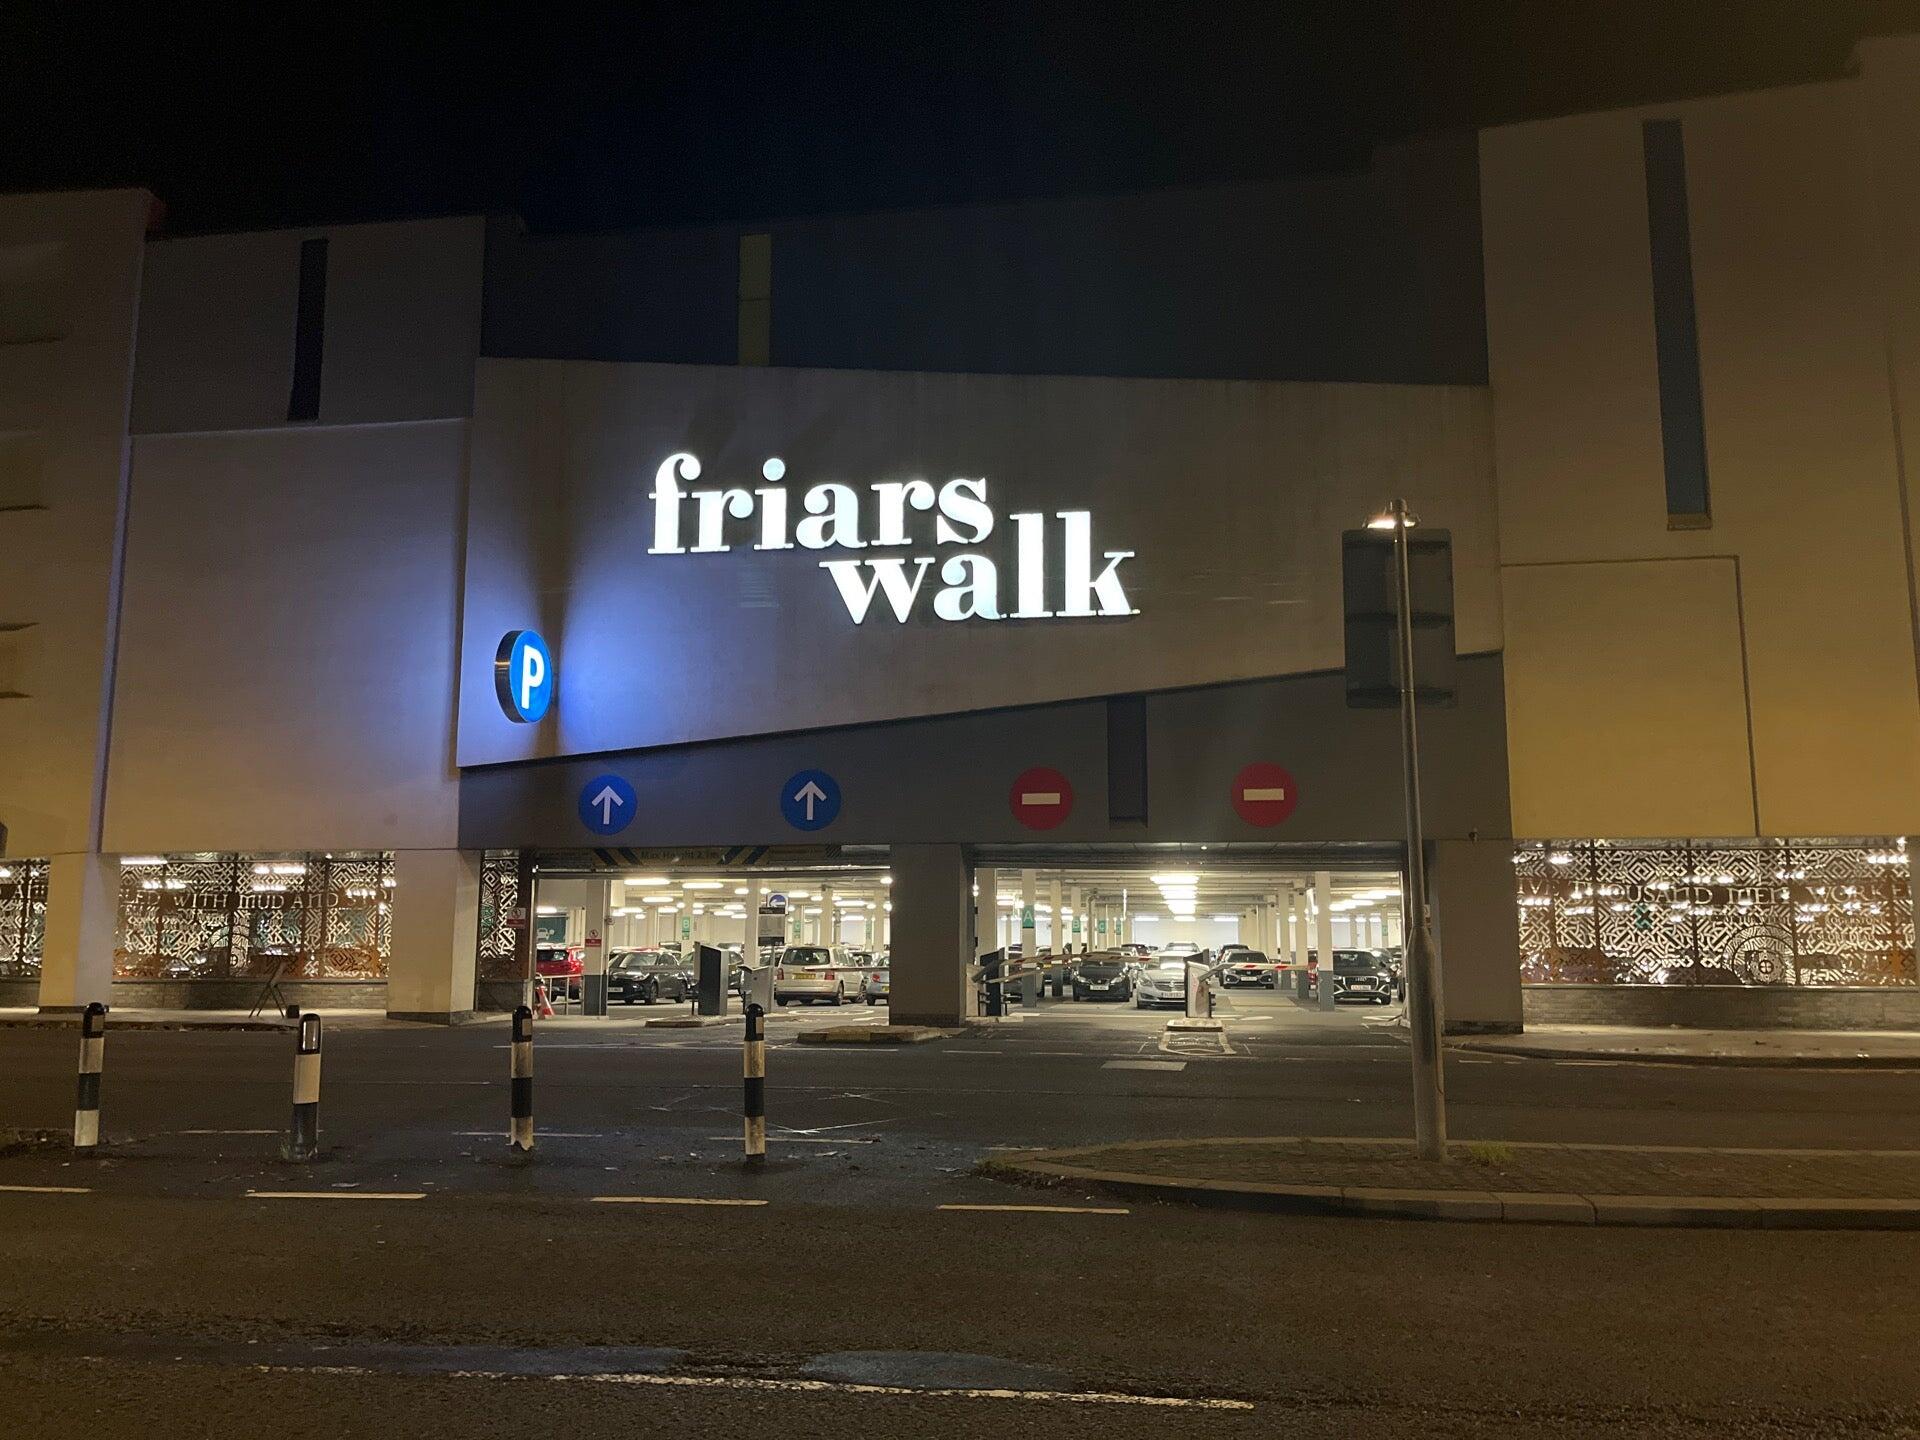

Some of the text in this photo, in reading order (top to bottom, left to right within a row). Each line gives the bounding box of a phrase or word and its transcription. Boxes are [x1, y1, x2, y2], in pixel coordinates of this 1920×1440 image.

[648, 453, 994, 554] friars
[819, 511, 1140, 625] walk
[522, 644, 545, 710] P
[174, 893, 228, 908] WITH
[238, 894, 285, 909] MUD
[291, 893, 339, 908] AND
[1023, 910, 1034, 922] A
